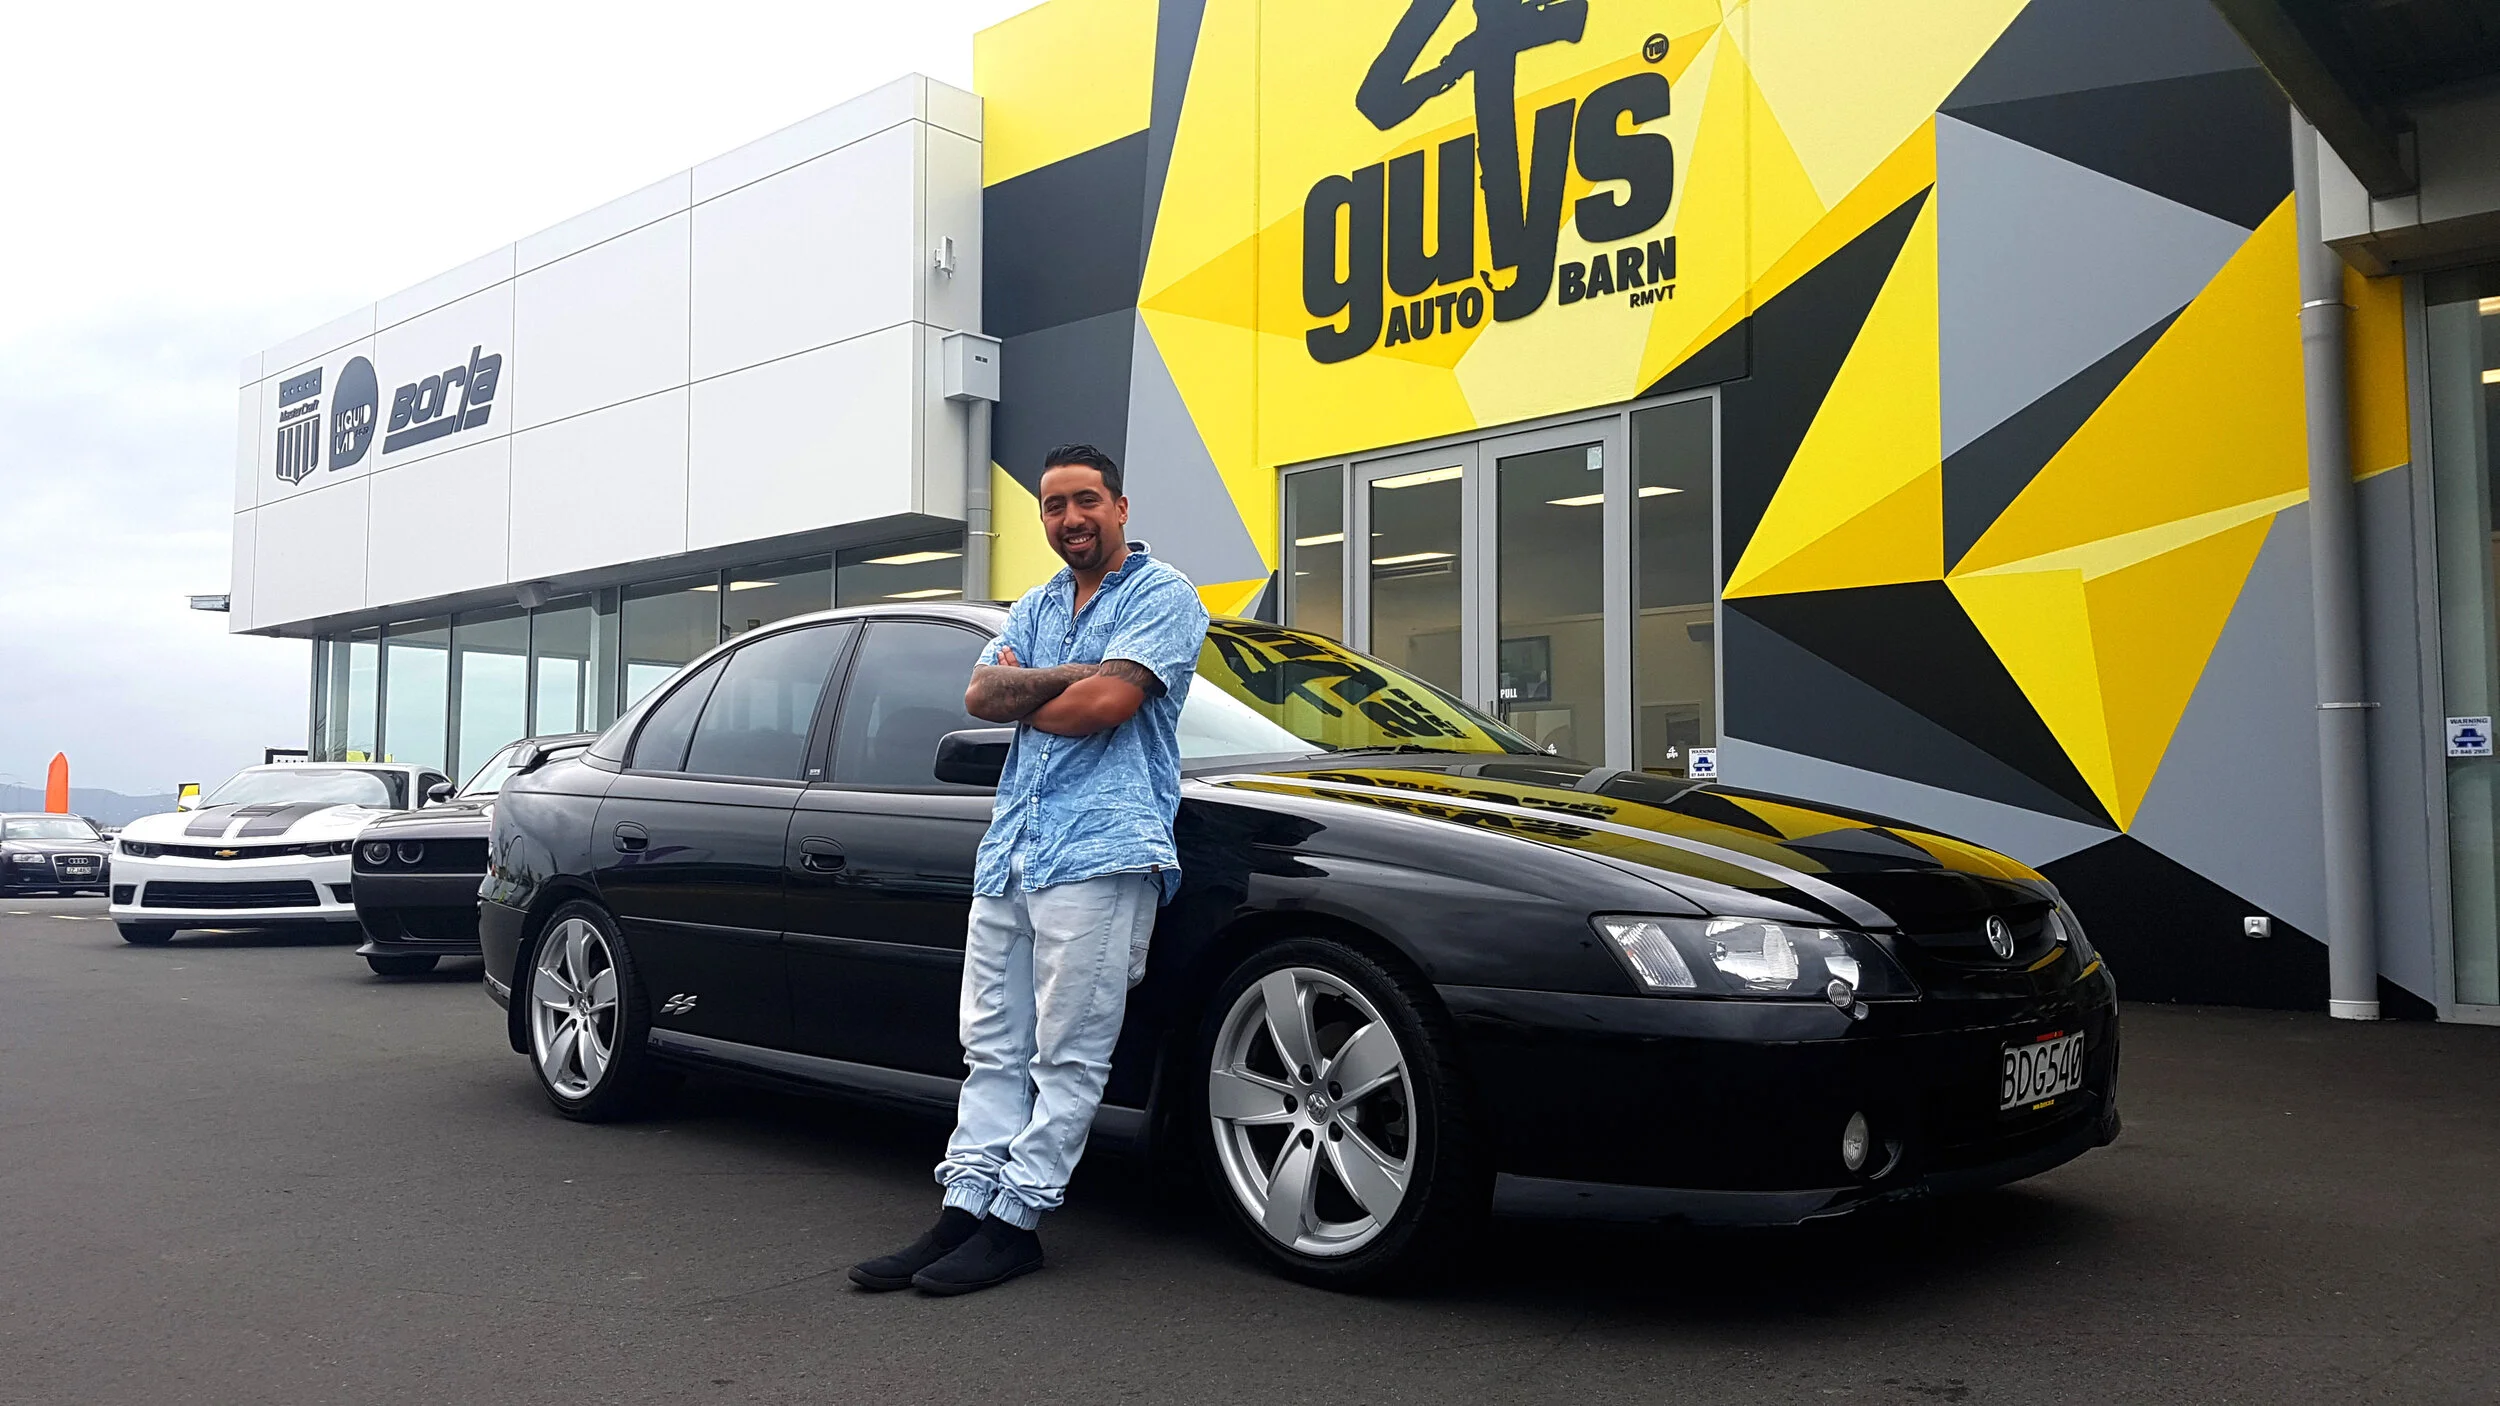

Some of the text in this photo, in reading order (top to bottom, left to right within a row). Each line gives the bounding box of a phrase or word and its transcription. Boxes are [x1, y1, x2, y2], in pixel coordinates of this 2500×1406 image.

[1303, 72, 1674, 363] guys
[1384, 236, 1676, 347] AUTO BARN
[1629, 284, 1676, 309] RMVT
[336, 404, 371, 433] LIQUID
[335, 431, 355, 455] LAB
[1500, 688, 1517, 699] PULL
[2001, 1036, 2083, 1106] BDG540
